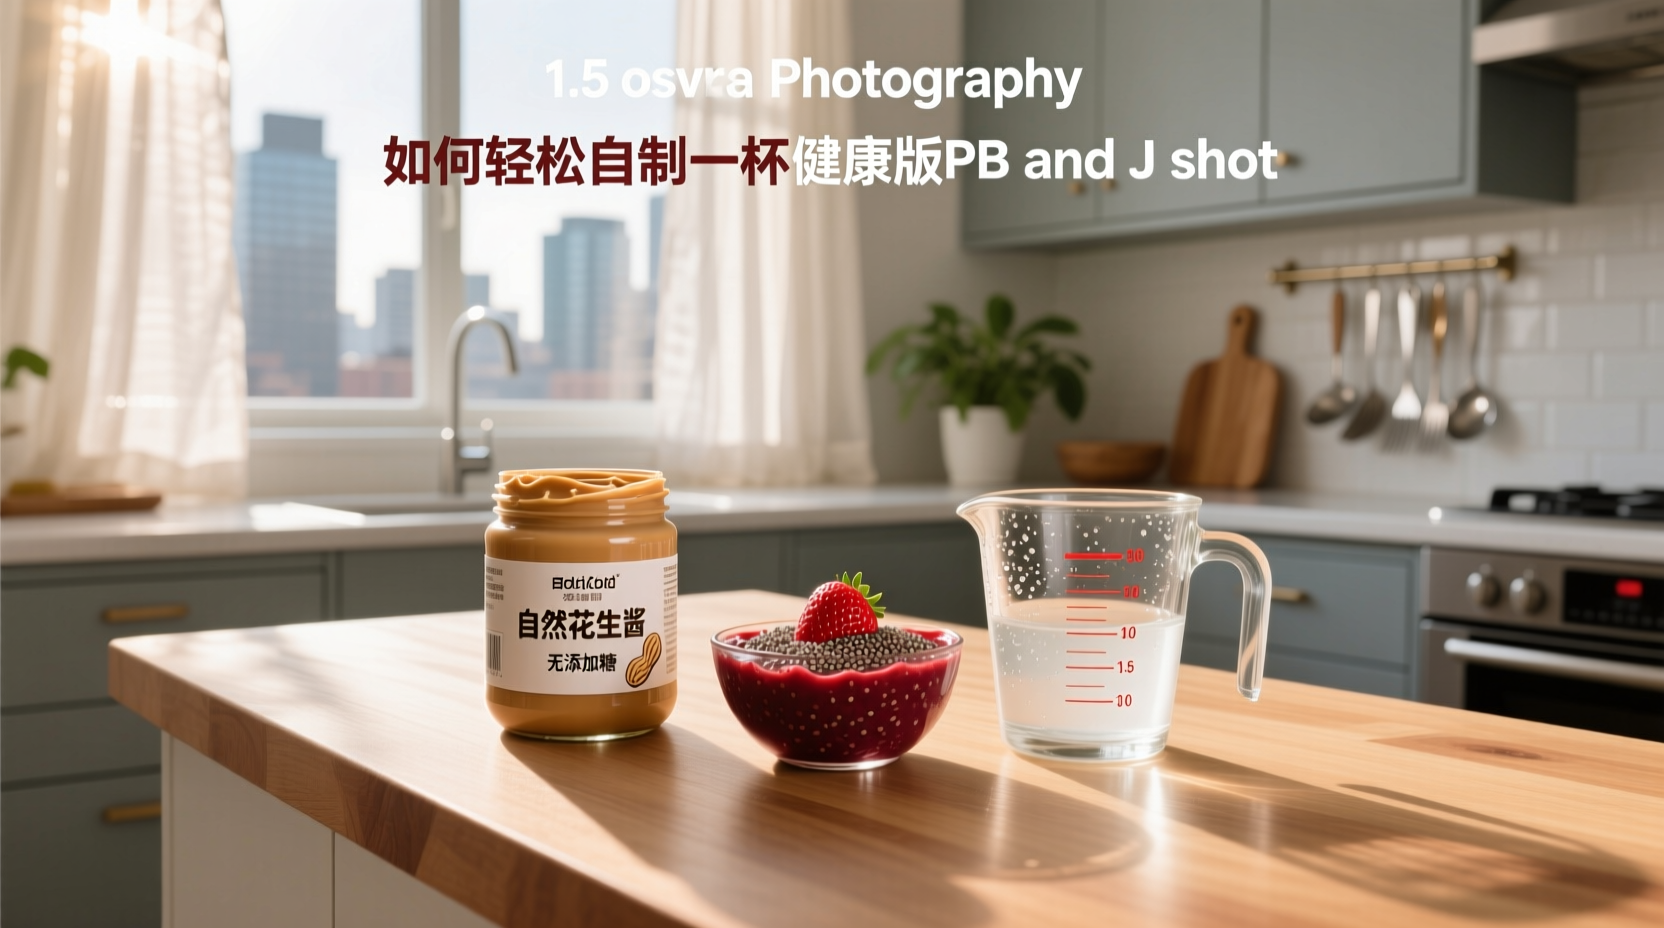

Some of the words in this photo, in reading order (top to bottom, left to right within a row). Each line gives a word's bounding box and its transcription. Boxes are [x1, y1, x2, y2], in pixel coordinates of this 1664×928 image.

[518, 607, 646, 640] 自然花生酱
[1121, 626, 1137, 640] 10
[547, 653, 617, 673] 无添加糖
